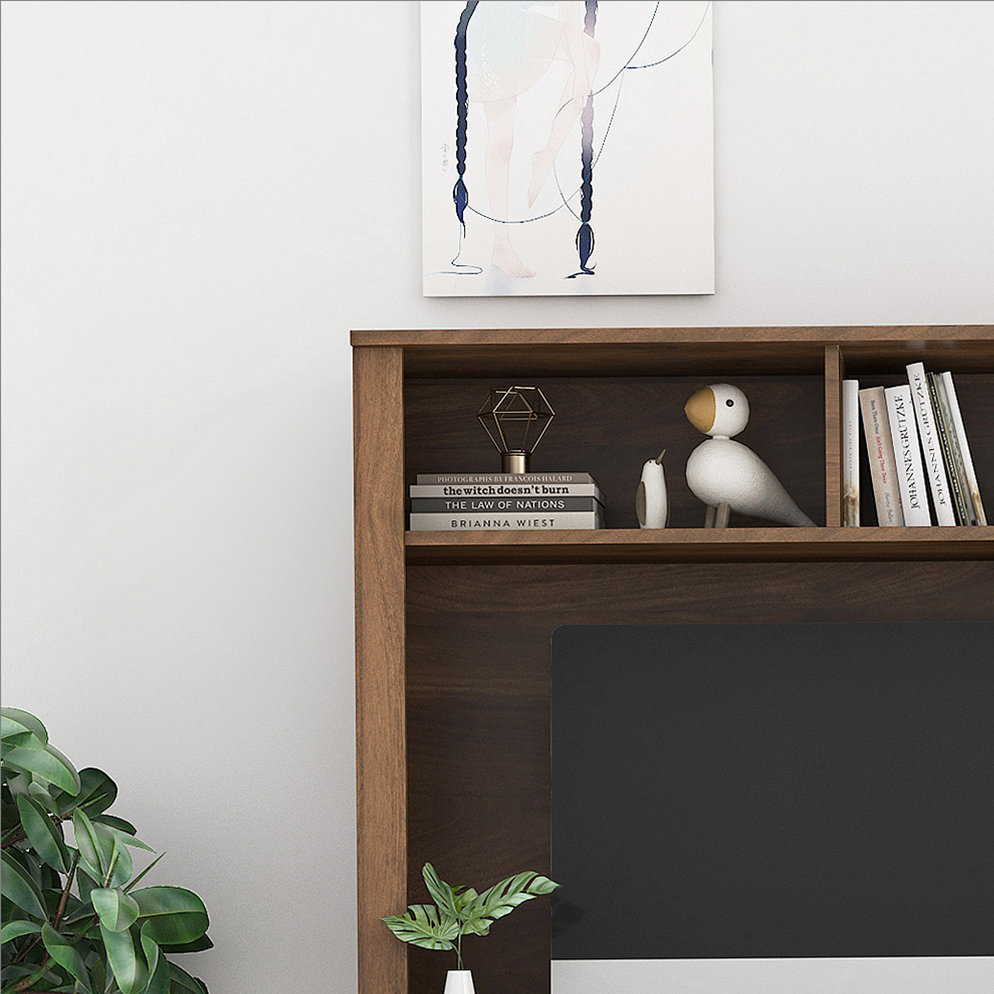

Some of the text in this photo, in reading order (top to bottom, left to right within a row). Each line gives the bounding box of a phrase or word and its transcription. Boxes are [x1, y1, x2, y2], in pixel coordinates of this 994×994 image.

[927, 437, 946, 505] JOHANNES
[437, 476, 493, 484] PHOTOGRAPHS
[542, 475, 573, 483] HALARD
[903, 449, 921, 509] JOHANNES
[443, 485, 570, 495] the witch doesn't burn
[445, 500, 565, 510] THE LAW OF NATIONS
[451, 519, 555, 528] BRIANNA WIEST
